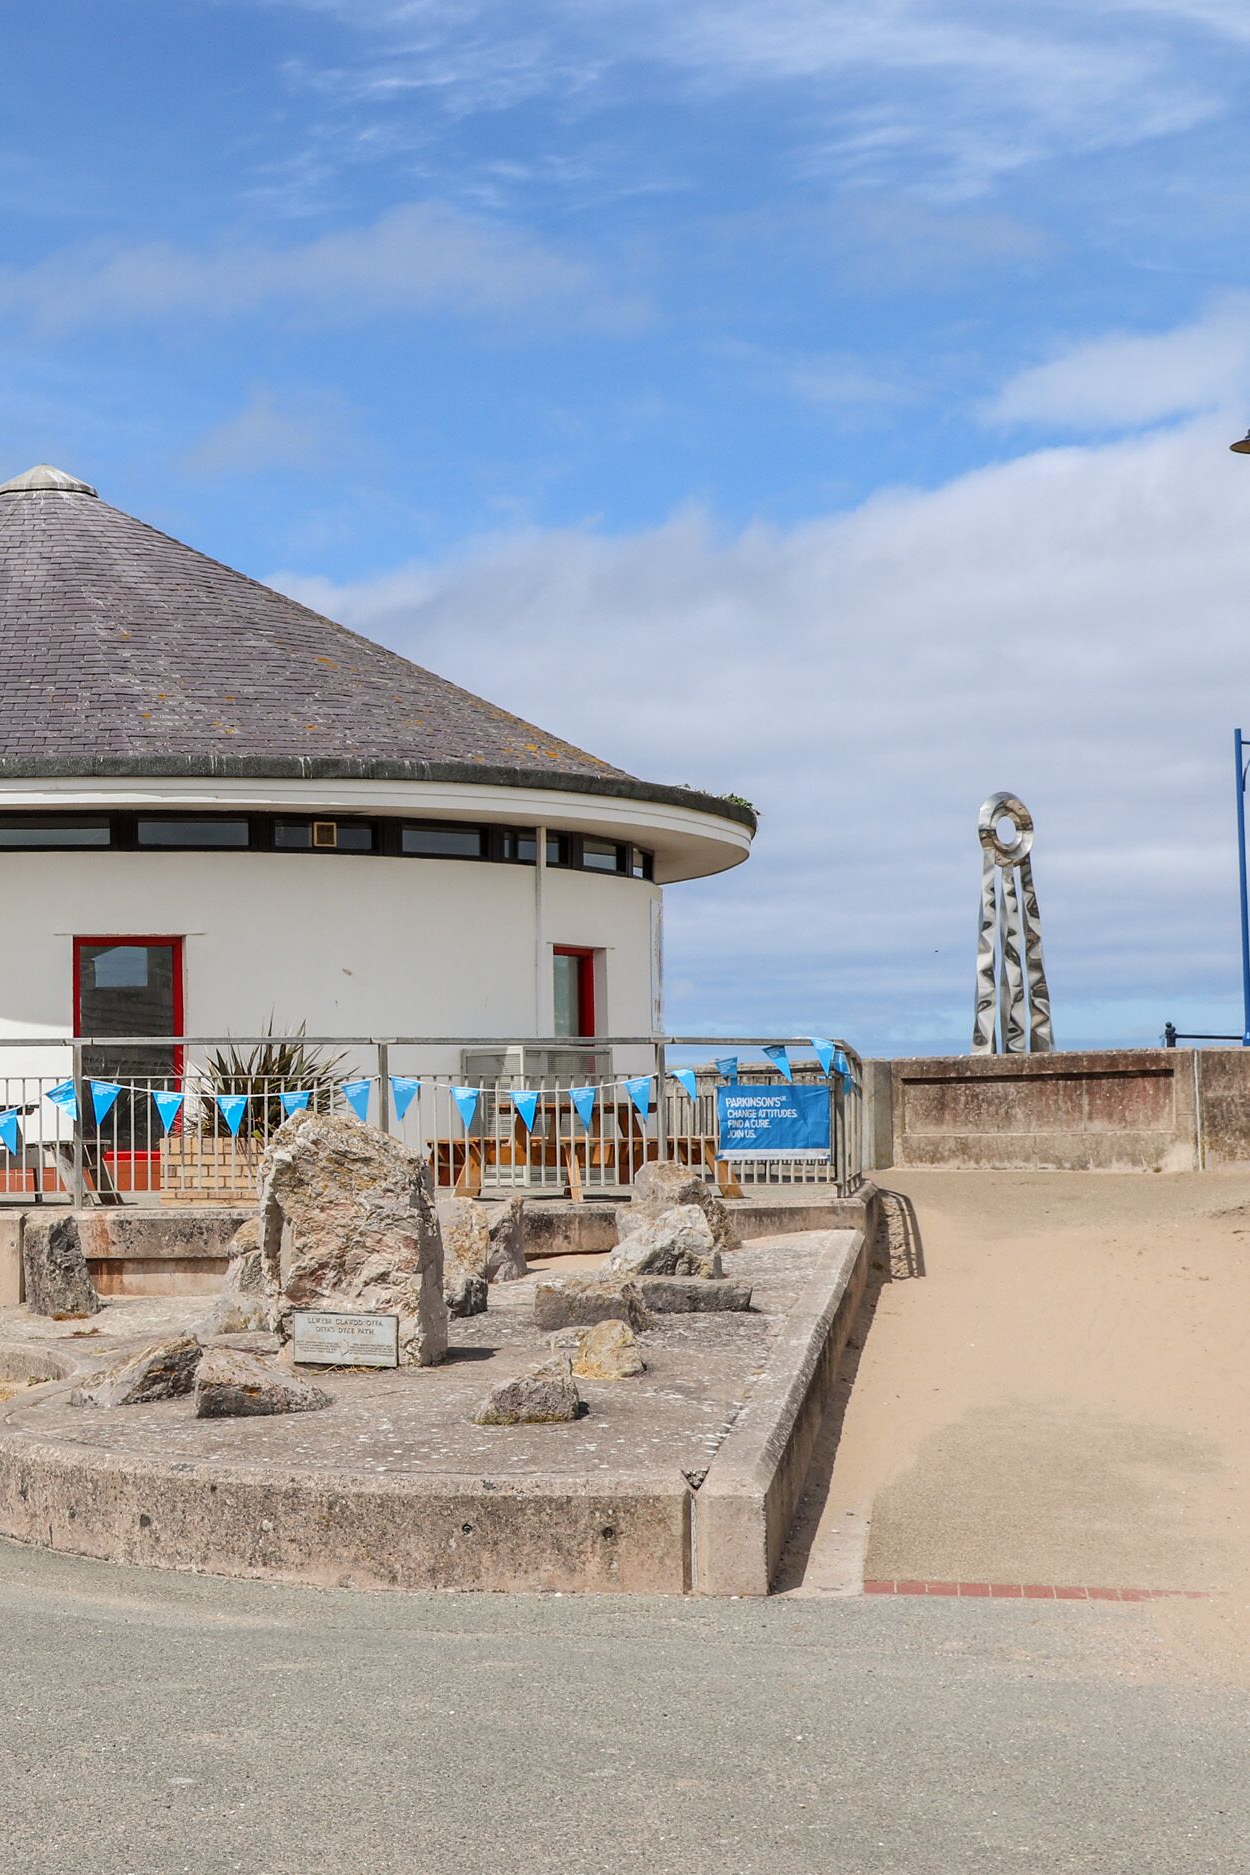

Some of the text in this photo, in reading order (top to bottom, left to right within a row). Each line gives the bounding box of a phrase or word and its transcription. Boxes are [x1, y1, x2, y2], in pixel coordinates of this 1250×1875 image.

[727, 1108, 798, 1118] CHANGE ATTITUDES.
[727, 1119, 772, 1128] FIND A CURE.
[727, 1129, 757, 1138] JOIN US.
